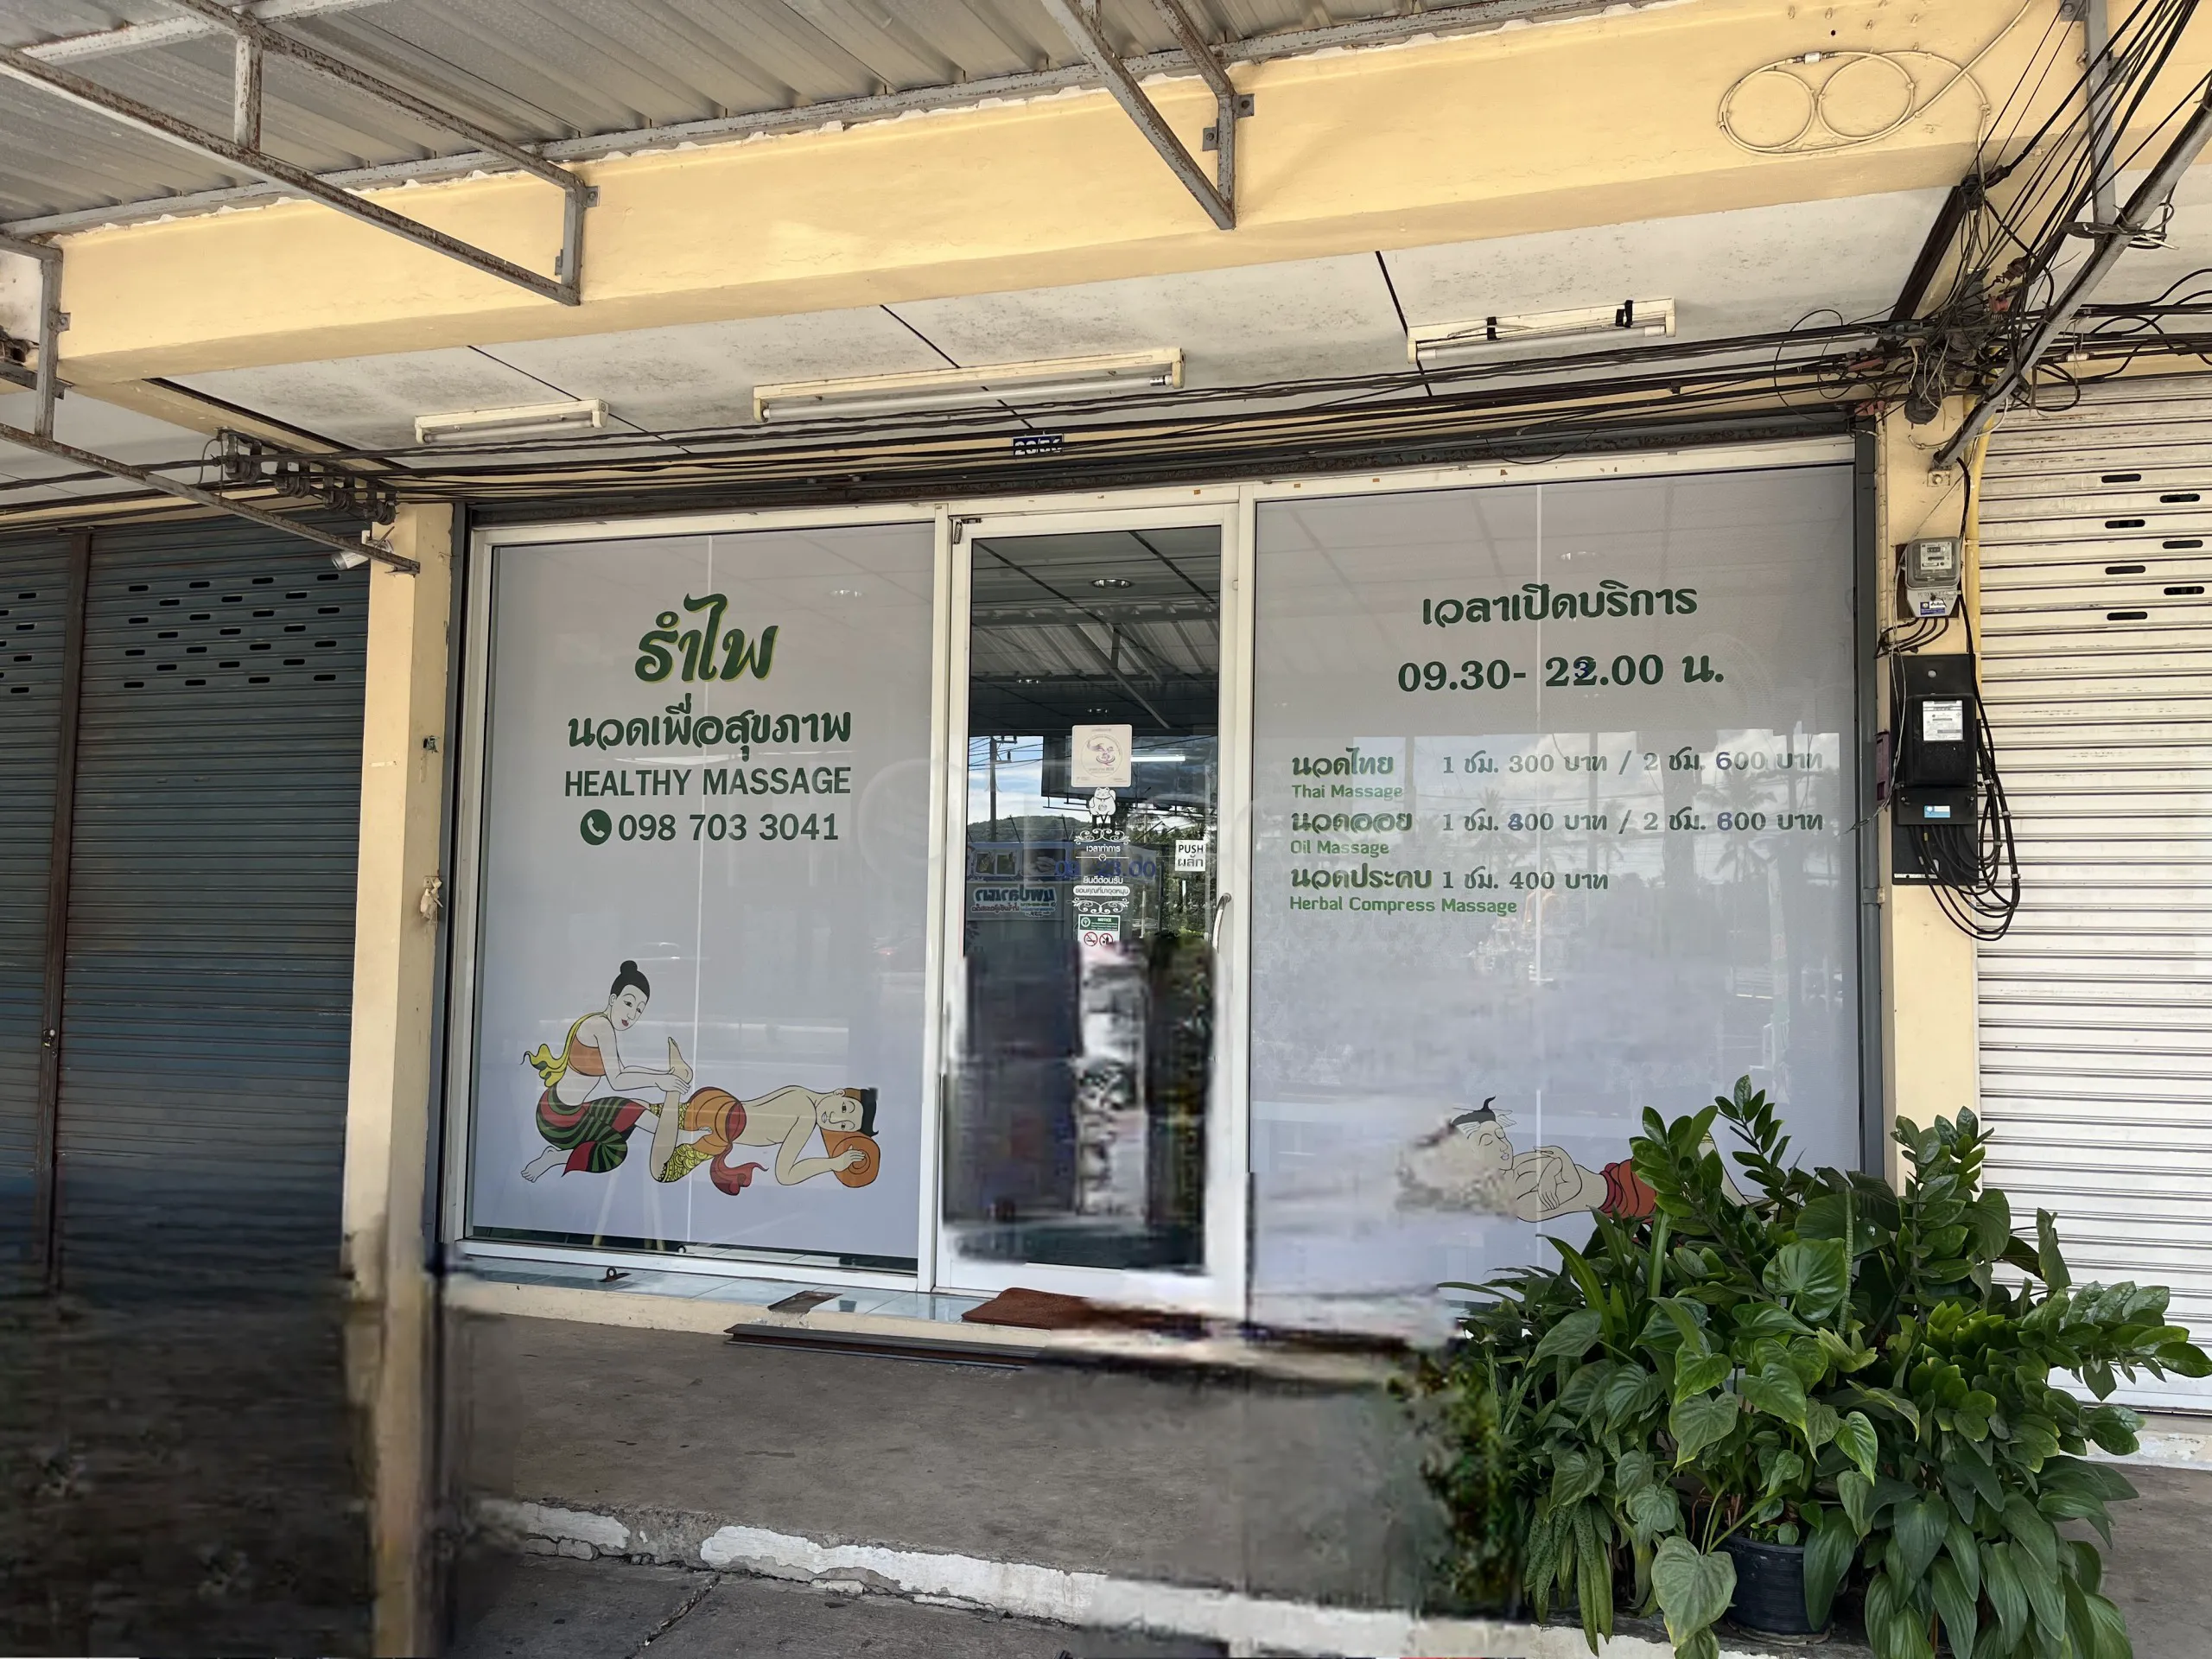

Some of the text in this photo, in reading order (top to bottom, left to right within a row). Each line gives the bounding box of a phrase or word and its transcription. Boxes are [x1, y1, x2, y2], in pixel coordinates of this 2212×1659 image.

[1423, 579, 1698, 628] เวลาเปิดบริการ
[635, 594, 779, 683] รำไพ
[1682, 654, 1724, 683] น.
[568, 693, 851, 762] นวดเพื่อสุขภาพ
[1292, 746, 1823, 778] นวดไทย 1 ชม. 300 บาท / 2 ชม. 600 บาท
[565, 766, 851, 797] HEALTHY MASSAGE
[1292, 785, 1403, 802] Thai Massage
[619, 813, 839, 841] 098 703 3041
[1291, 812, 1413, 834] นวดออย
[1443, 813, 1454, 831] 1
[1464, 807, 1499, 831] ชม.
[1564, 814, 1607, 830] บาท
[1618, 809, 1632, 835] /
[1643, 812, 1658, 830] 2
[1669, 806, 1707, 830] ชม.
[1777, 813, 1823, 830] บาท
[1086, 843, 1121, 853] เวลาทำการ
[1178, 855, 1203, 867] ผลัก
[1179, 844, 1204, 854] PUSH
[1290, 840, 1389, 858] Oil Massage
[1291, 862, 1609, 891] นวดประคบ 1 ชม. 400 บาท
[1290, 895, 1517, 917] Herbal Compress Massage
